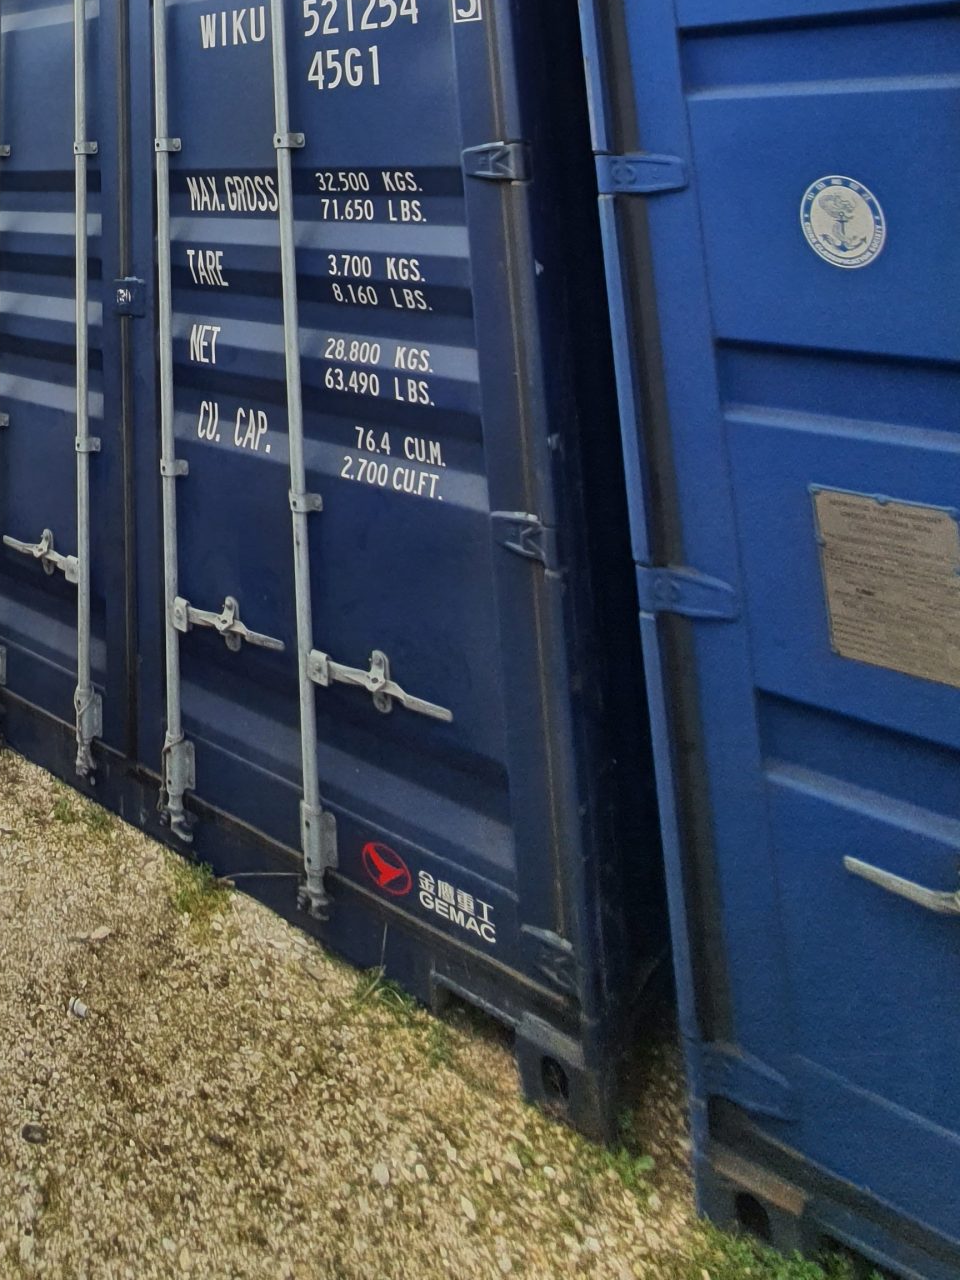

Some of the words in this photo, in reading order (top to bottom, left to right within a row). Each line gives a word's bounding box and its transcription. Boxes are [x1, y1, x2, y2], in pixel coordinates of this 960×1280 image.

[200, 6, 266, 49] WIKU
[307, 45, 380, 90] 45G1
[186, 175, 279, 213] MAX.GROSS
[315, 172, 370, 192] 32.500
[382, 172, 423, 192] KGS.
[320, 198, 374, 221] 71.650
[388, 200, 427, 223] LBS.
[186, 250, 230, 287] TARE
[327, 254, 372, 278] 3.700
[386, 257, 426, 283] KGS.
[332, 283, 378, 306] 8.160
[393, 287, 433, 312] LBS.
[190, 323, 222, 365] NET
[324, 338, 381, 365] 28.800
[394, 346, 434, 373] KGS.
[324, 368, 380, 397] 63.490
[394, 377, 435, 407] LBS.
[197, 400, 221, 442] CU.
[233, 407, 272, 454] CAP.
[354, 426, 391, 456] 76.4
[404, 436, 447, 468] CU.M.
[340, 456, 388, 487] 2.700
[392, 466, 443, 501] CU.FT.
[419, 891, 497, 944] GEMAC
